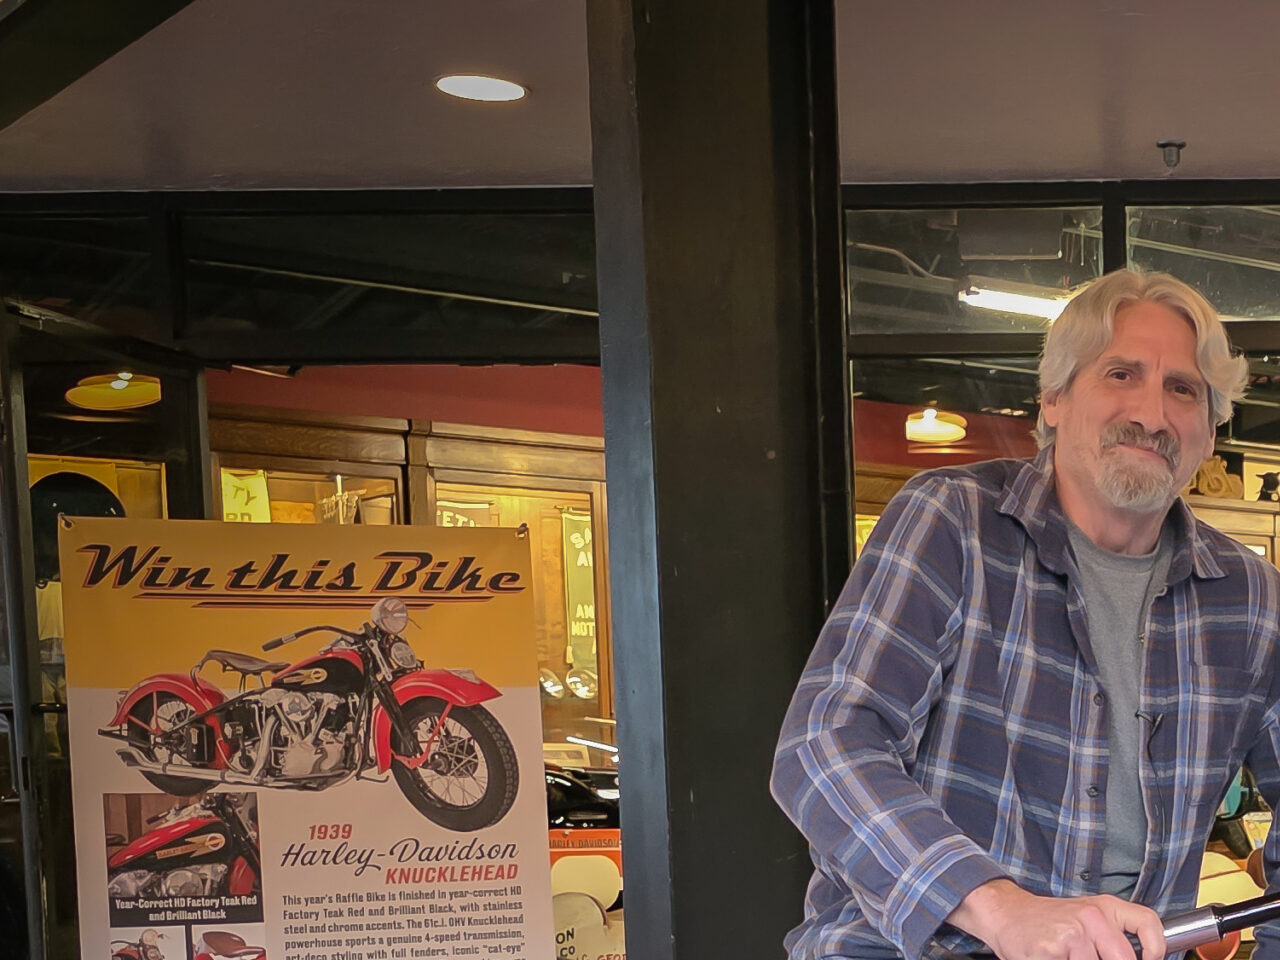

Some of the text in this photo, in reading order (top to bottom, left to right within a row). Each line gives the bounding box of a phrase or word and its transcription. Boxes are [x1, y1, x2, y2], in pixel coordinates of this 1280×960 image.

[76, 543, 527, 595] Win this Bike
[308, 823, 353, 841] 1939
[280, 837, 520, 877] Harley-Davidson
[385, 863, 519, 885] KNUCKLEHEAD
[115, 895, 257, 910] Year-Correct HD Factory Teak Red
[283, 886, 521, 907] This year's Raffle Bike is finished in year-correct HD
[149, 908, 226, 921] and Brilliant Black
[283, 901, 523, 921] Factory Teak Red and Brilliant Black, with stainless
[284, 923, 307, 934] steel
[309, 923, 326, 933] and
[328, 922, 364, 932] chrome
[366, 920, 404, 931] accents.
[407, 919, 422, 929] The
[449, 917, 466, 927] OHV
[468, 914, 524, 926] Knucklehead
[285, 929, 525, 950] powerhouse sports a genuine 4-speed transmission,
[367, 950, 387, 959] with
[391, 948, 406, 958] full
[410, 946, 449, 957] fenders,
[452, 945, 479, 955] iconic
